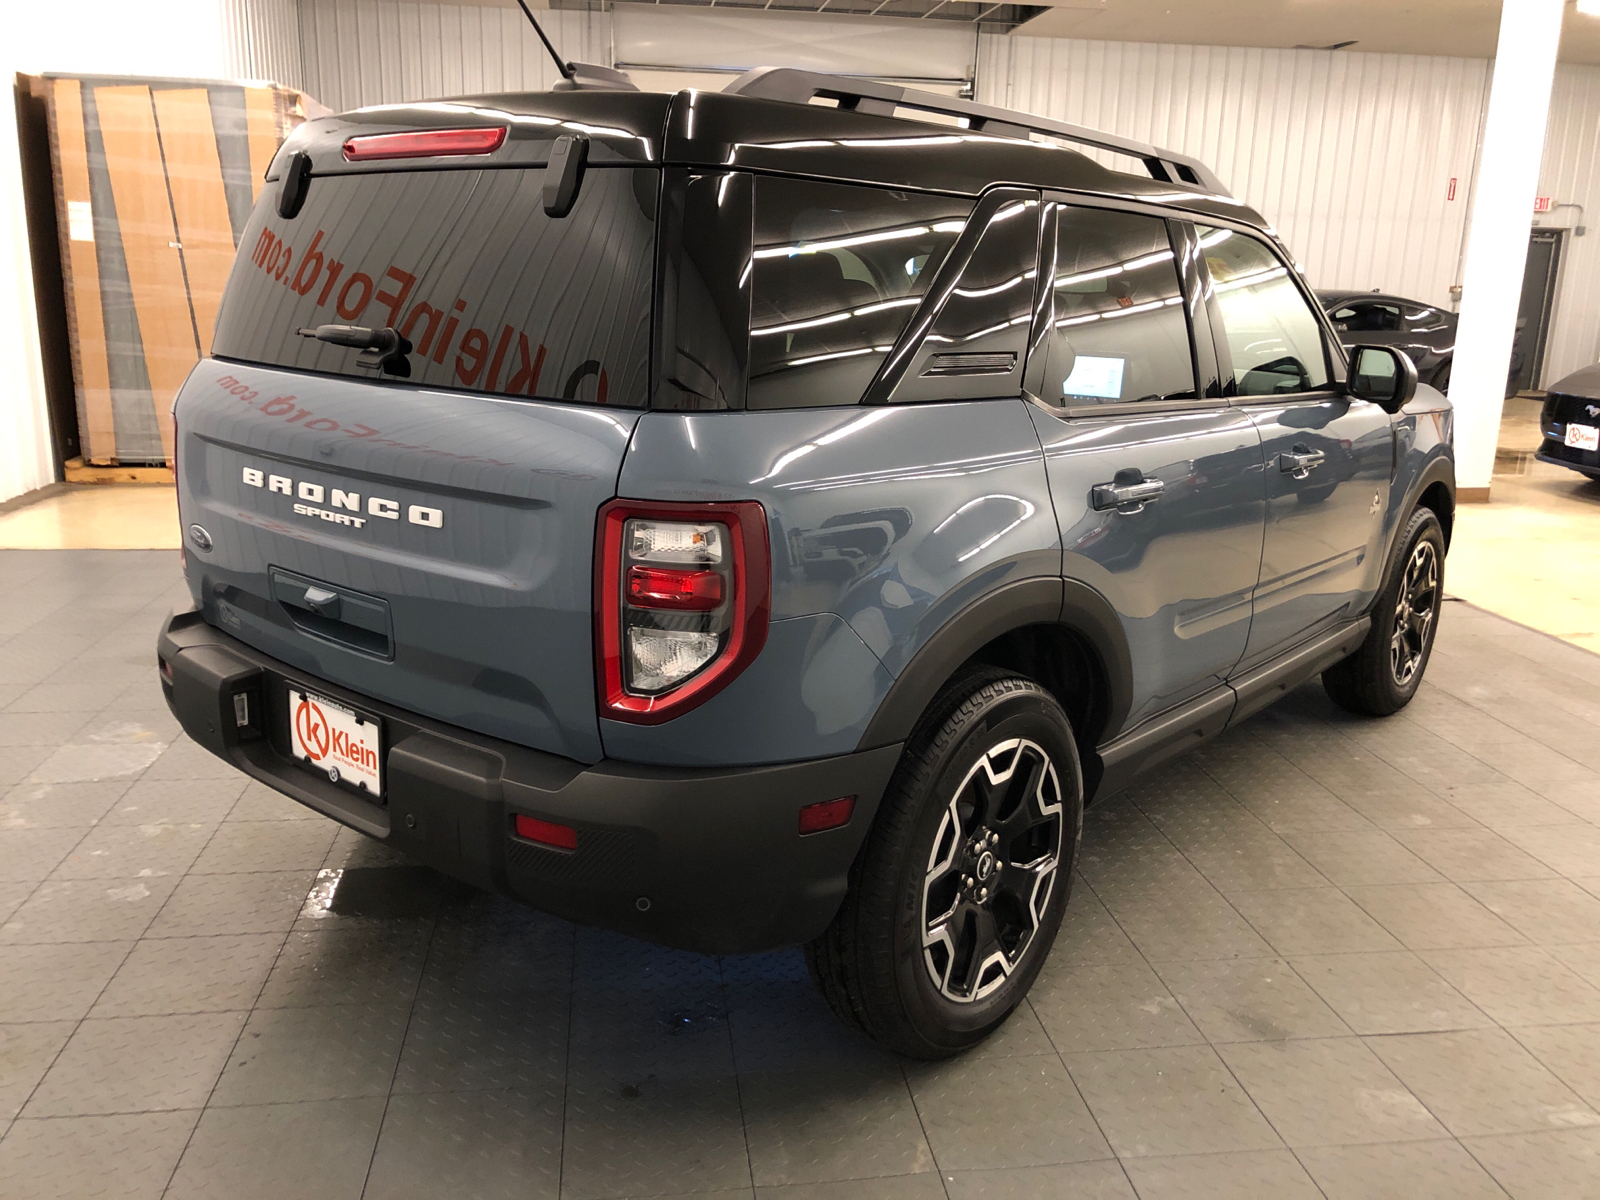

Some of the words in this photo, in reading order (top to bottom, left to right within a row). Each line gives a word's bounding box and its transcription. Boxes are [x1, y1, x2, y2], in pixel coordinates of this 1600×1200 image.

[1534, 197, 1550, 210] EXIT
[242, 466, 443, 529] BRONCO
[293, 503, 367, 528] SPORT
[331, 727, 377, 770] Klein
